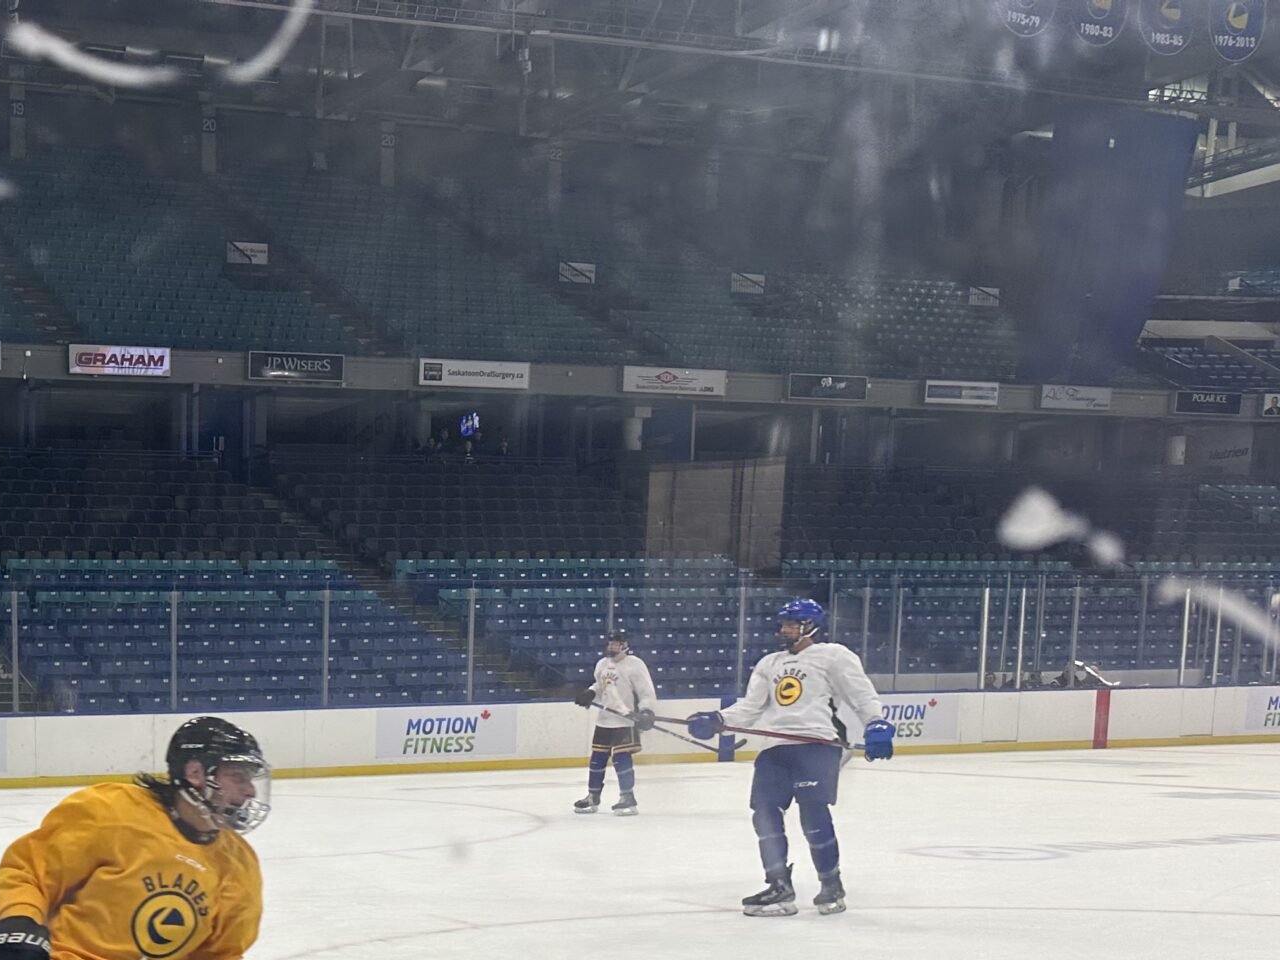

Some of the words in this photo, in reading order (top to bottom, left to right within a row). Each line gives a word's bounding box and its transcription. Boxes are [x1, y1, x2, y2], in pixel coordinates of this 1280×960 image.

[1080, 23, 1113, 38] 1980-83
[1214, 34, 1256, 48] 1976-2013
[11, 102, 25, 116] 19
[202, 118, 217, 132] 20
[75, 352, 165, 367] GRAHAM
[447, 369, 524, 380] SaskatoonOralSurgery.ca
[1192, 393, 1214, 403] POLAR
[1215, 394, 1227, 403] ICE
[881, 704, 926, 720] OTION
[406, 717, 478, 735] MOTION
[402, 736, 475, 754] FITNESS
[142, 872, 208, 917] BLADES
